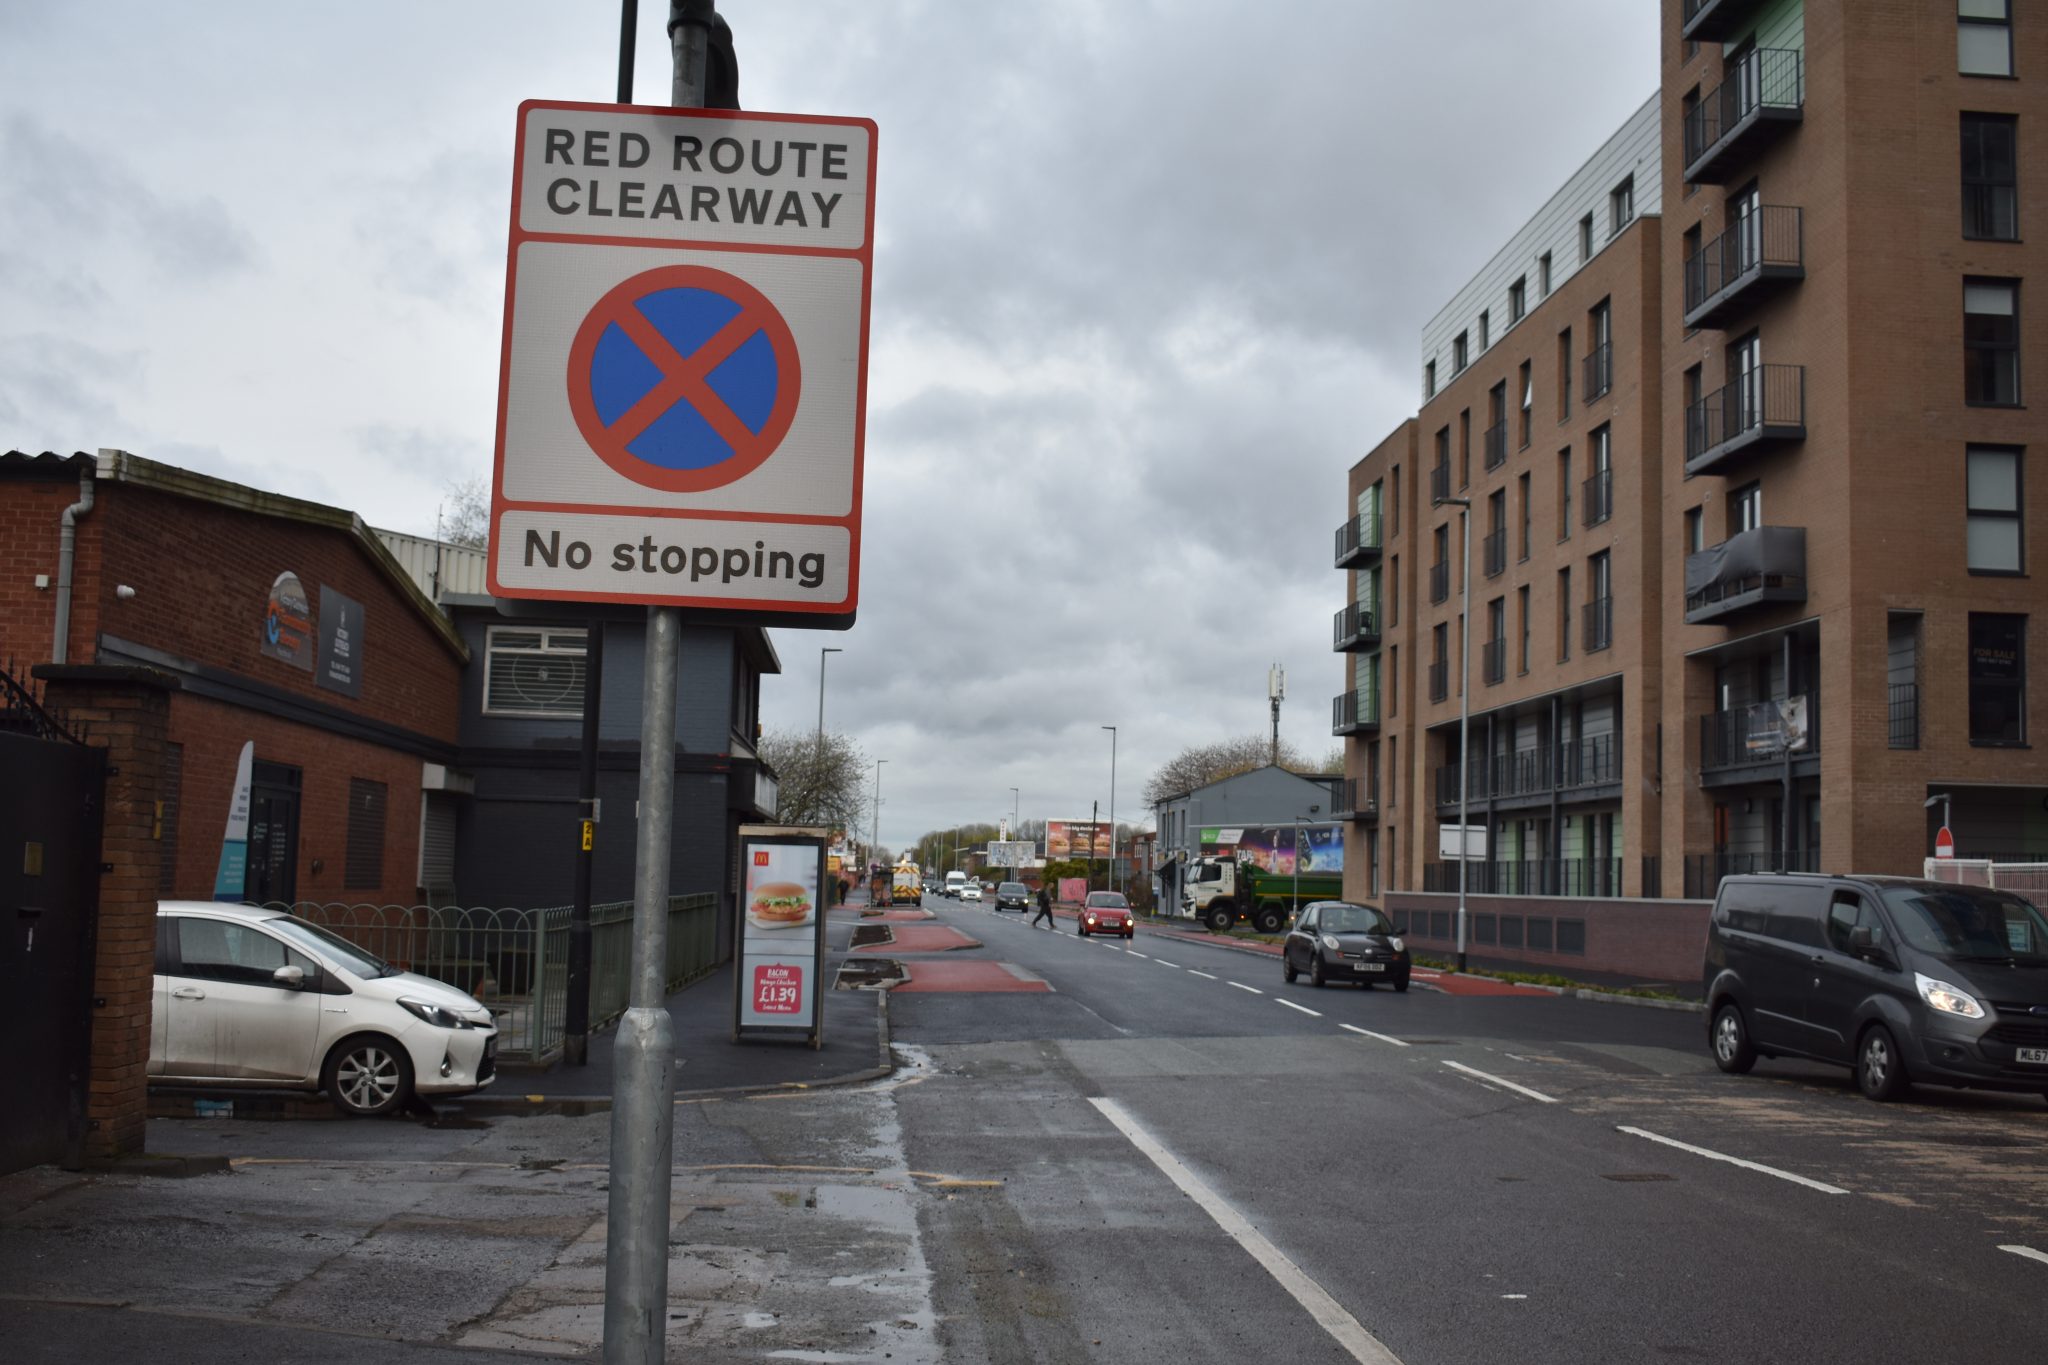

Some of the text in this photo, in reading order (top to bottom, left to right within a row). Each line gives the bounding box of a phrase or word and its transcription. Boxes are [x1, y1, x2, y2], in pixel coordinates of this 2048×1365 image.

[544, 128, 849, 180] RED ROUTE
[546, 178, 843, 229] CLEARWAY
[524, 529, 826, 589] No stopping
[759, 986, 797, 1004] £1.39
